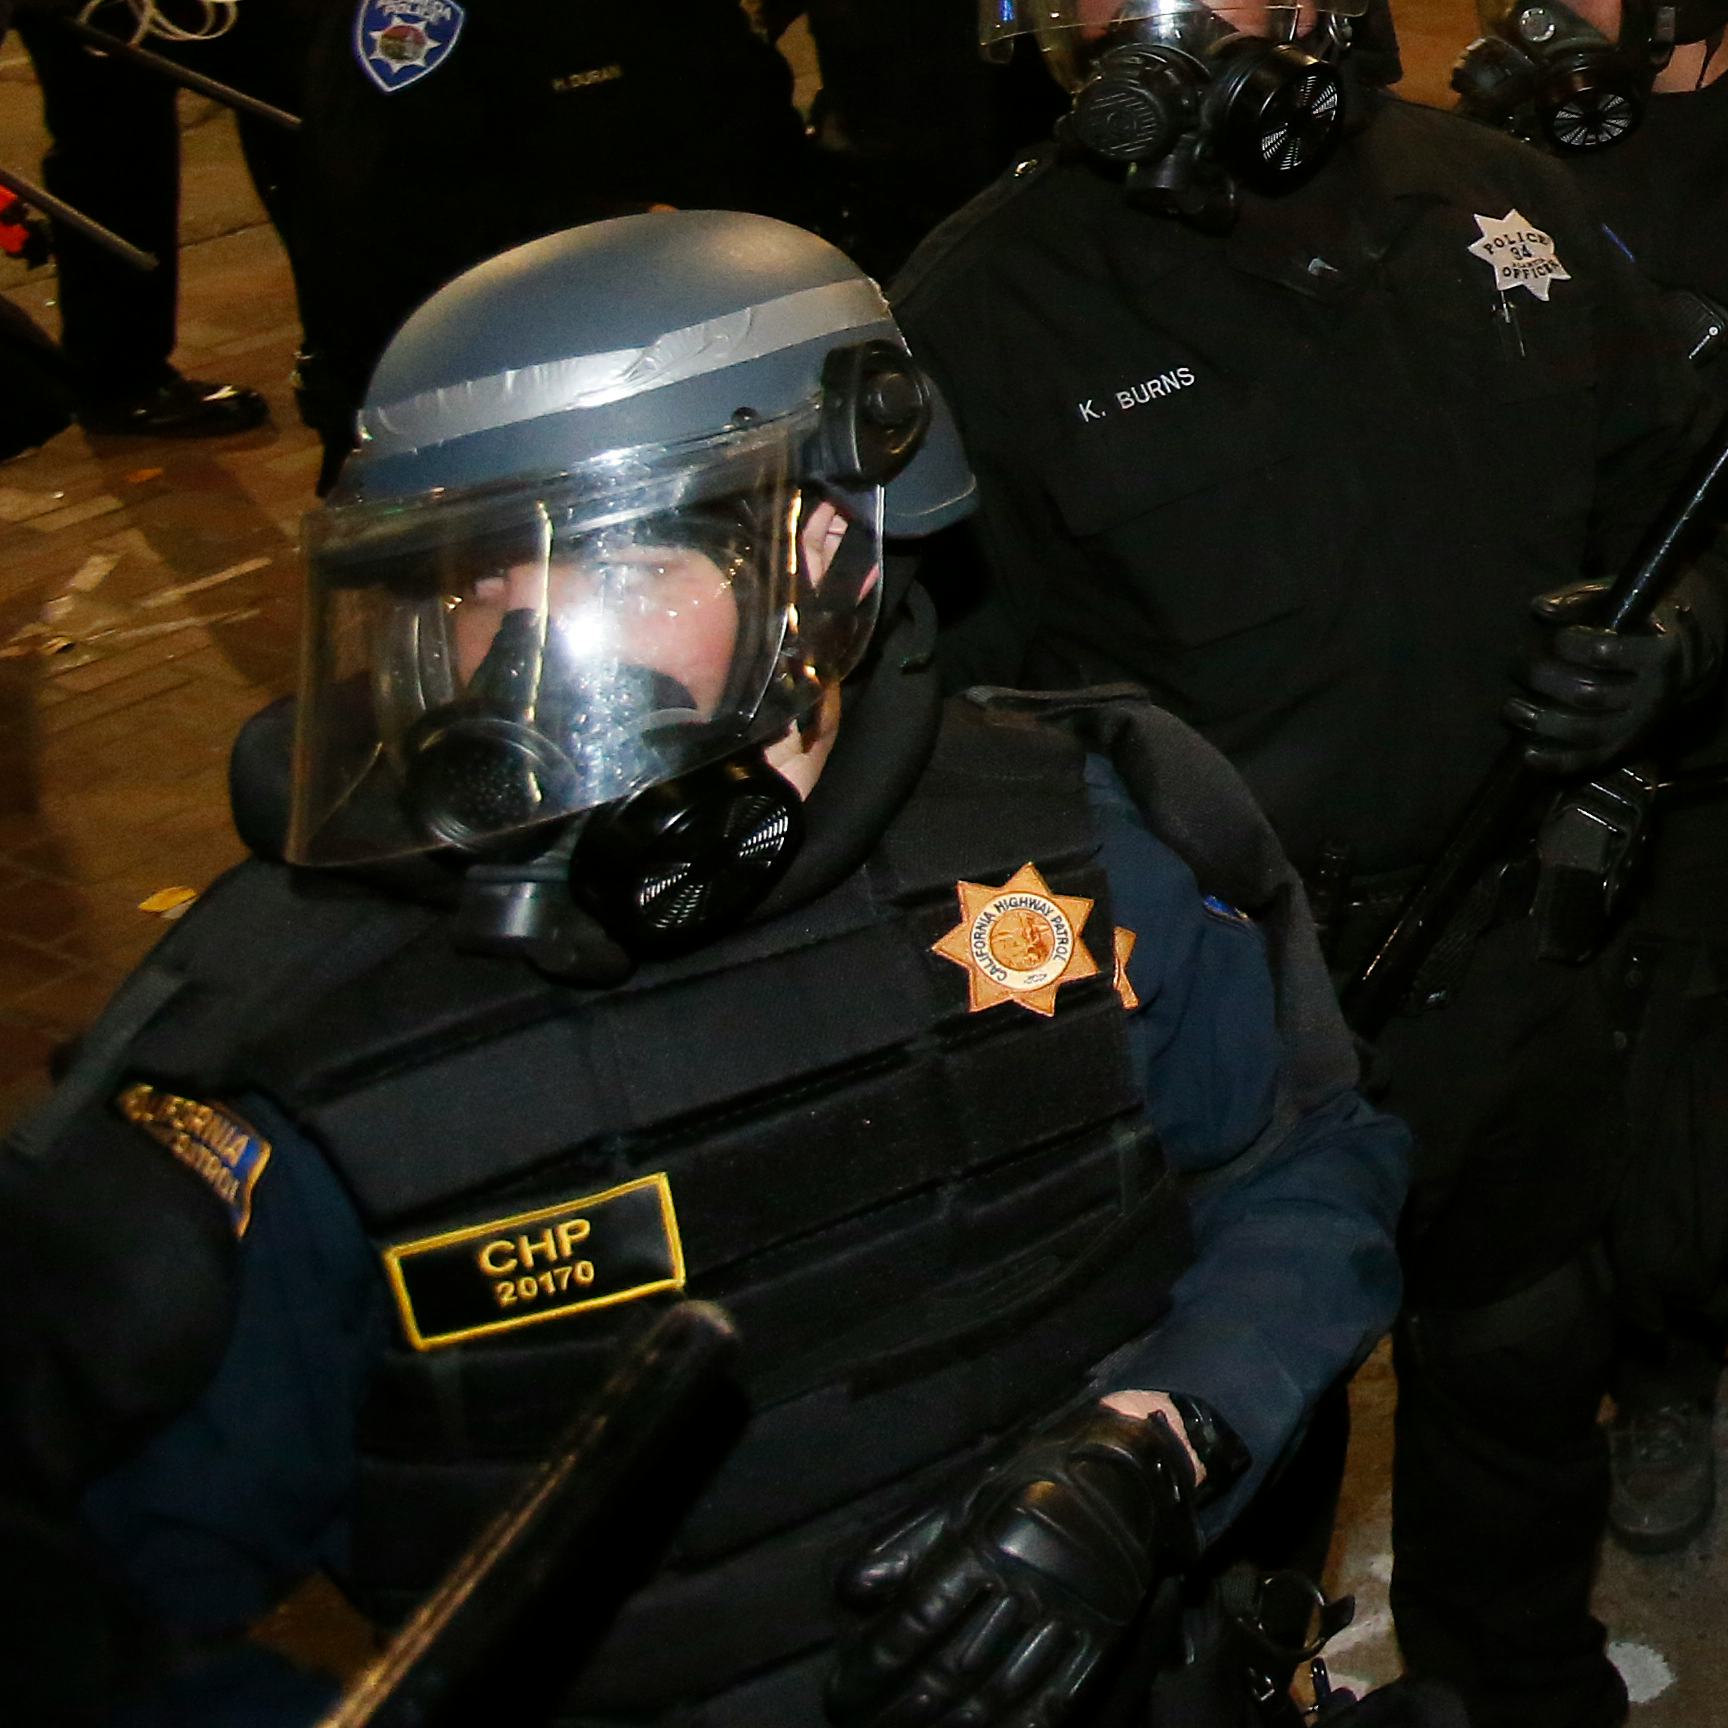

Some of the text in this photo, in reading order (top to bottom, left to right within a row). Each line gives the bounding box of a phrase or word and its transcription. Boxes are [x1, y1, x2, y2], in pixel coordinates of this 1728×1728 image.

[1483, 232, 1549, 255] POLICE
[1079, 367, 1195, 422] K. BURNS
[974, 897, 1069, 981] CALIFORNIA HIGHWAY PATROL
[479, 1219, 593, 1276] CHP
[494, 1260, 597, 1309] 20170
